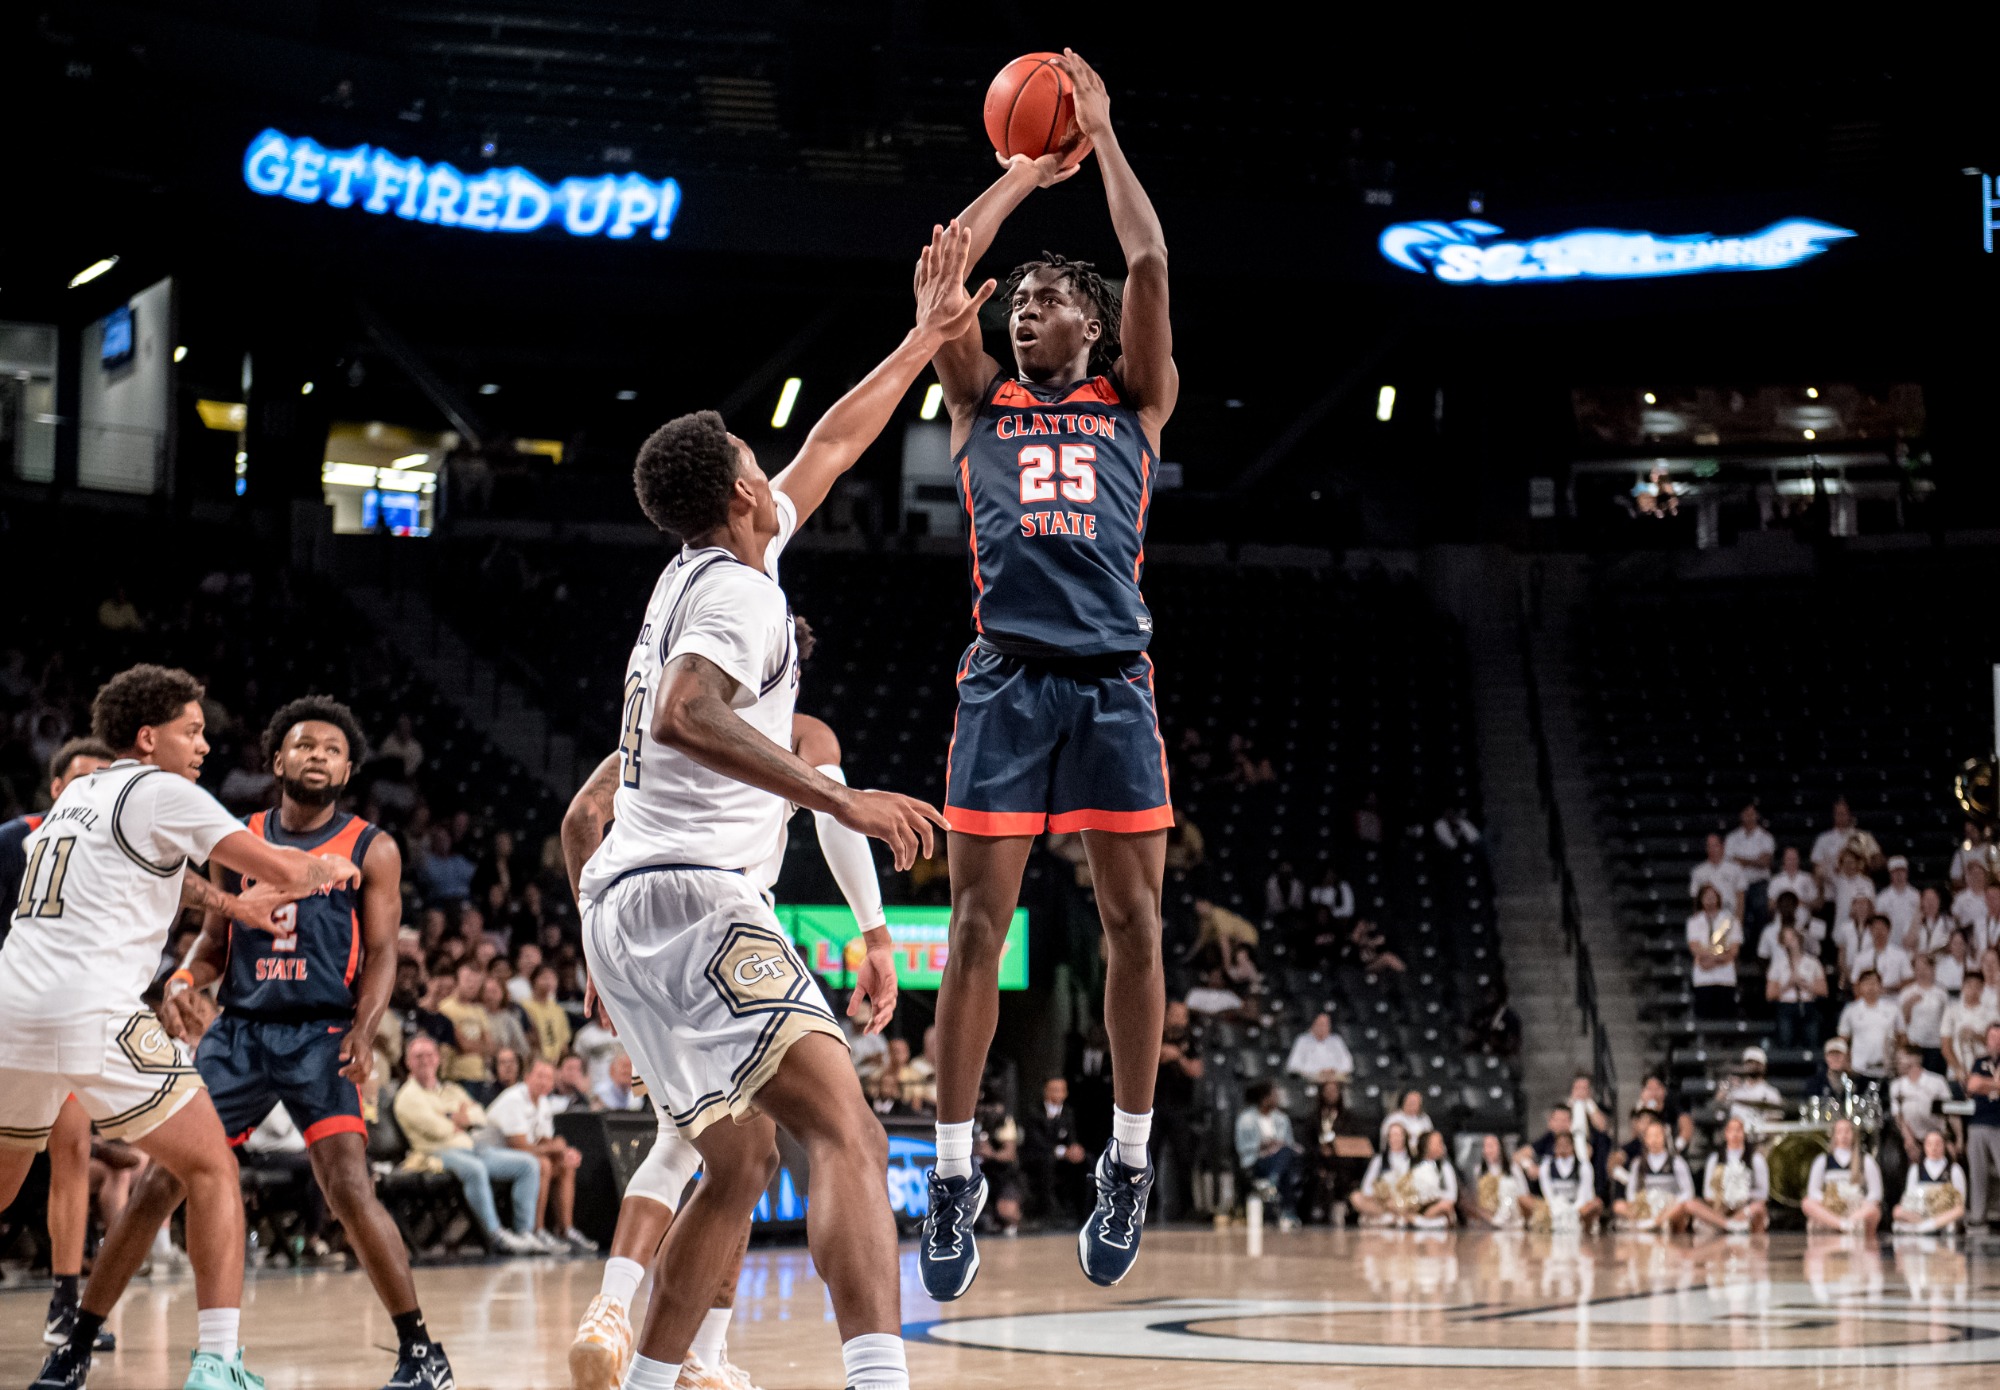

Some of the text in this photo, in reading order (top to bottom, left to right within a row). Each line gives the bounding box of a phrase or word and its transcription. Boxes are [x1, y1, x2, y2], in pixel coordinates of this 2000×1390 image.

[246, 130, 681, 240] GET FIRED UP!
[996, 413, 1117, 440] CLAYTON
[1017, 443, 1097, 504] 25
[1020, 511, 1098, 540] STATE
[620, 670, 648, 790] 4
[14, 835, 77, 921] 11
[271, 901, 298, 952] 2
[255, 957, 308, 981] STATE
[733, 952, 785, 987] GT
